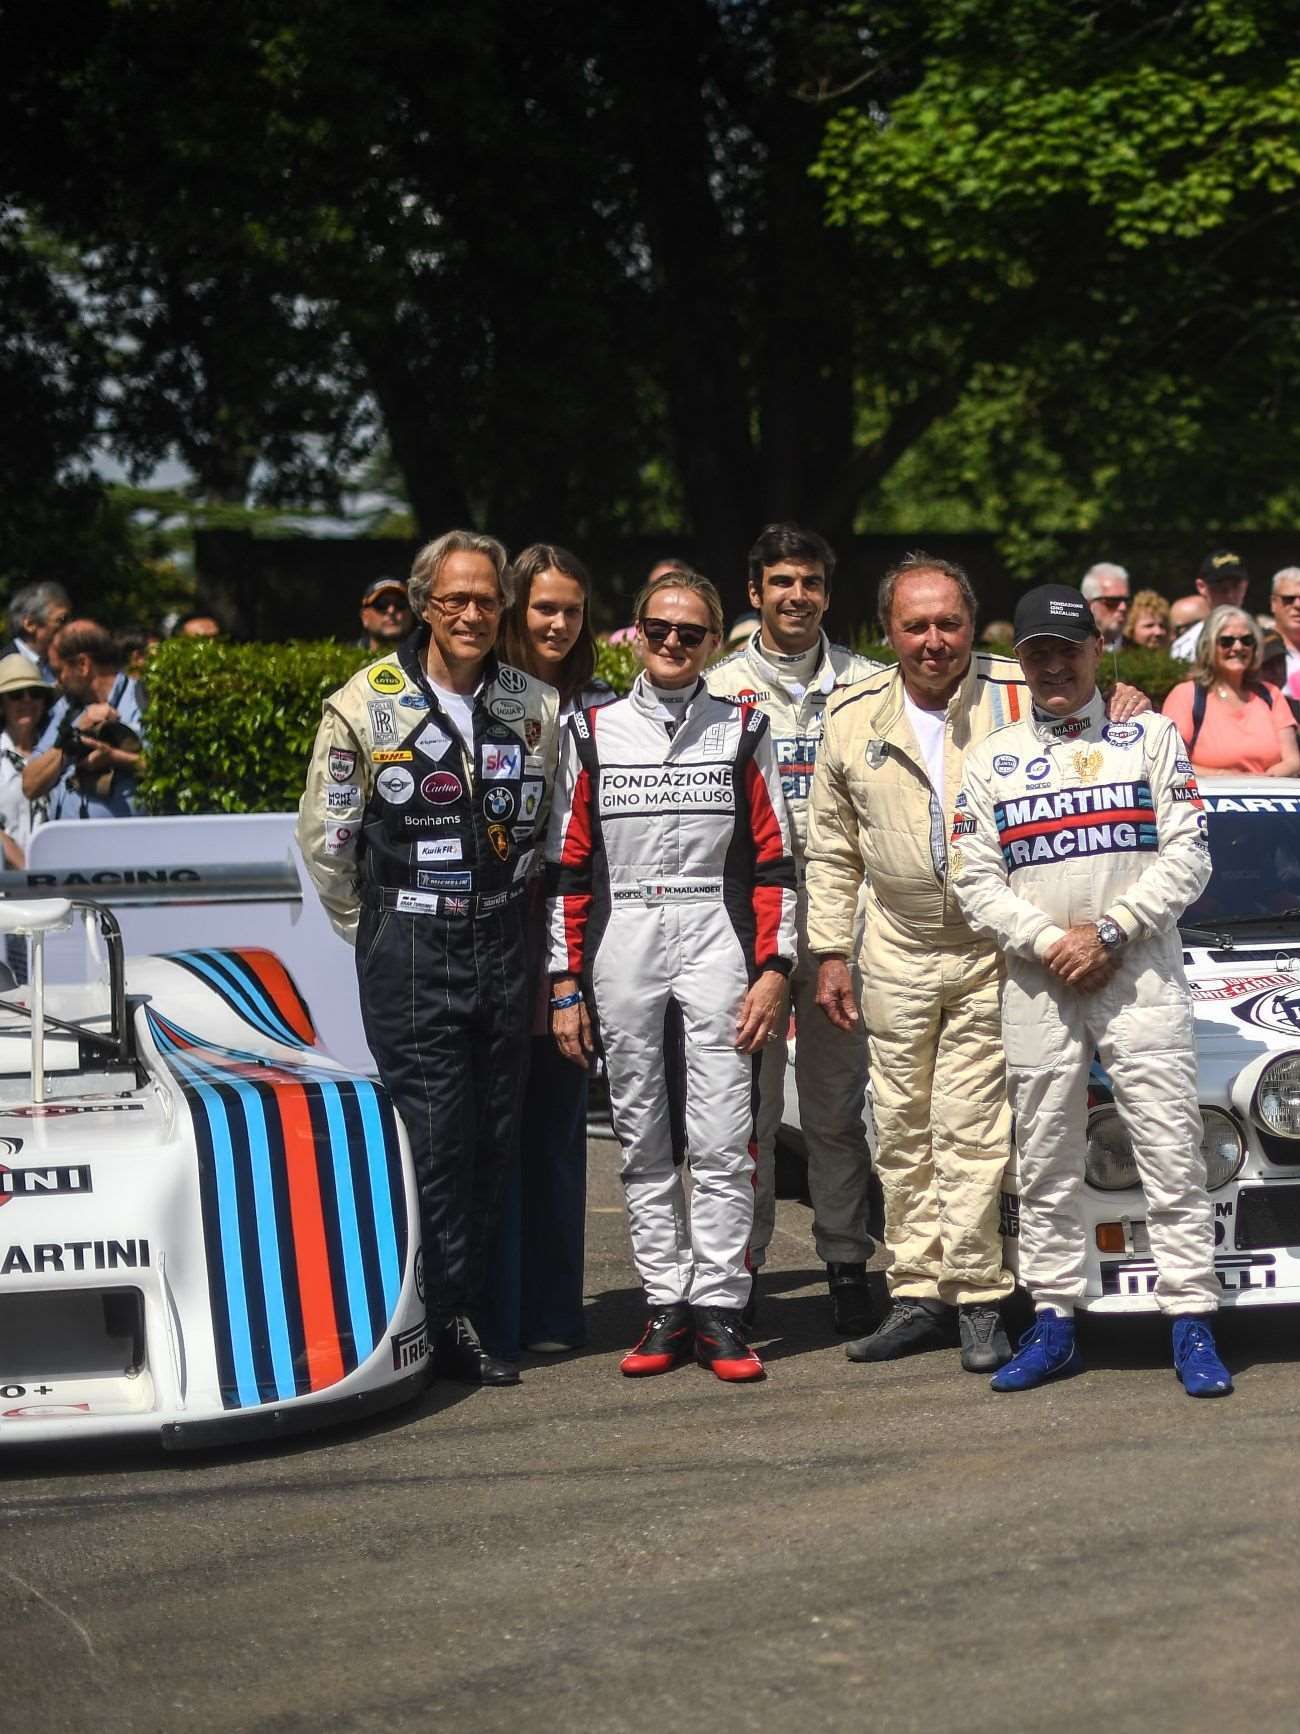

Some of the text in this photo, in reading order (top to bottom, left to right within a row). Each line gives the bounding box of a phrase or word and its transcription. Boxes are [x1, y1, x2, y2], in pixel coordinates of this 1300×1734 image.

[1054, 717, 1090, 735] MARTINI
[487, 750, 518, 775] sky
[425, 781, 460, 794] Cartier
[602, 771, 732, 790] FONDAZIONE
[328, 792, 352, 800] MONT
[602, 791, 733, 807] GINO MACALUSO
[1006, 784, 1134, 827] MARTINI
[405, 814, 461, 826] Bonhams
[1010, 823, 1137, 865] RACING
[26, 869, 200, 887] RACING
[1191, 989, 1234, 1000] ONTE
[0, 1239, 151, 1275] ARTINI
